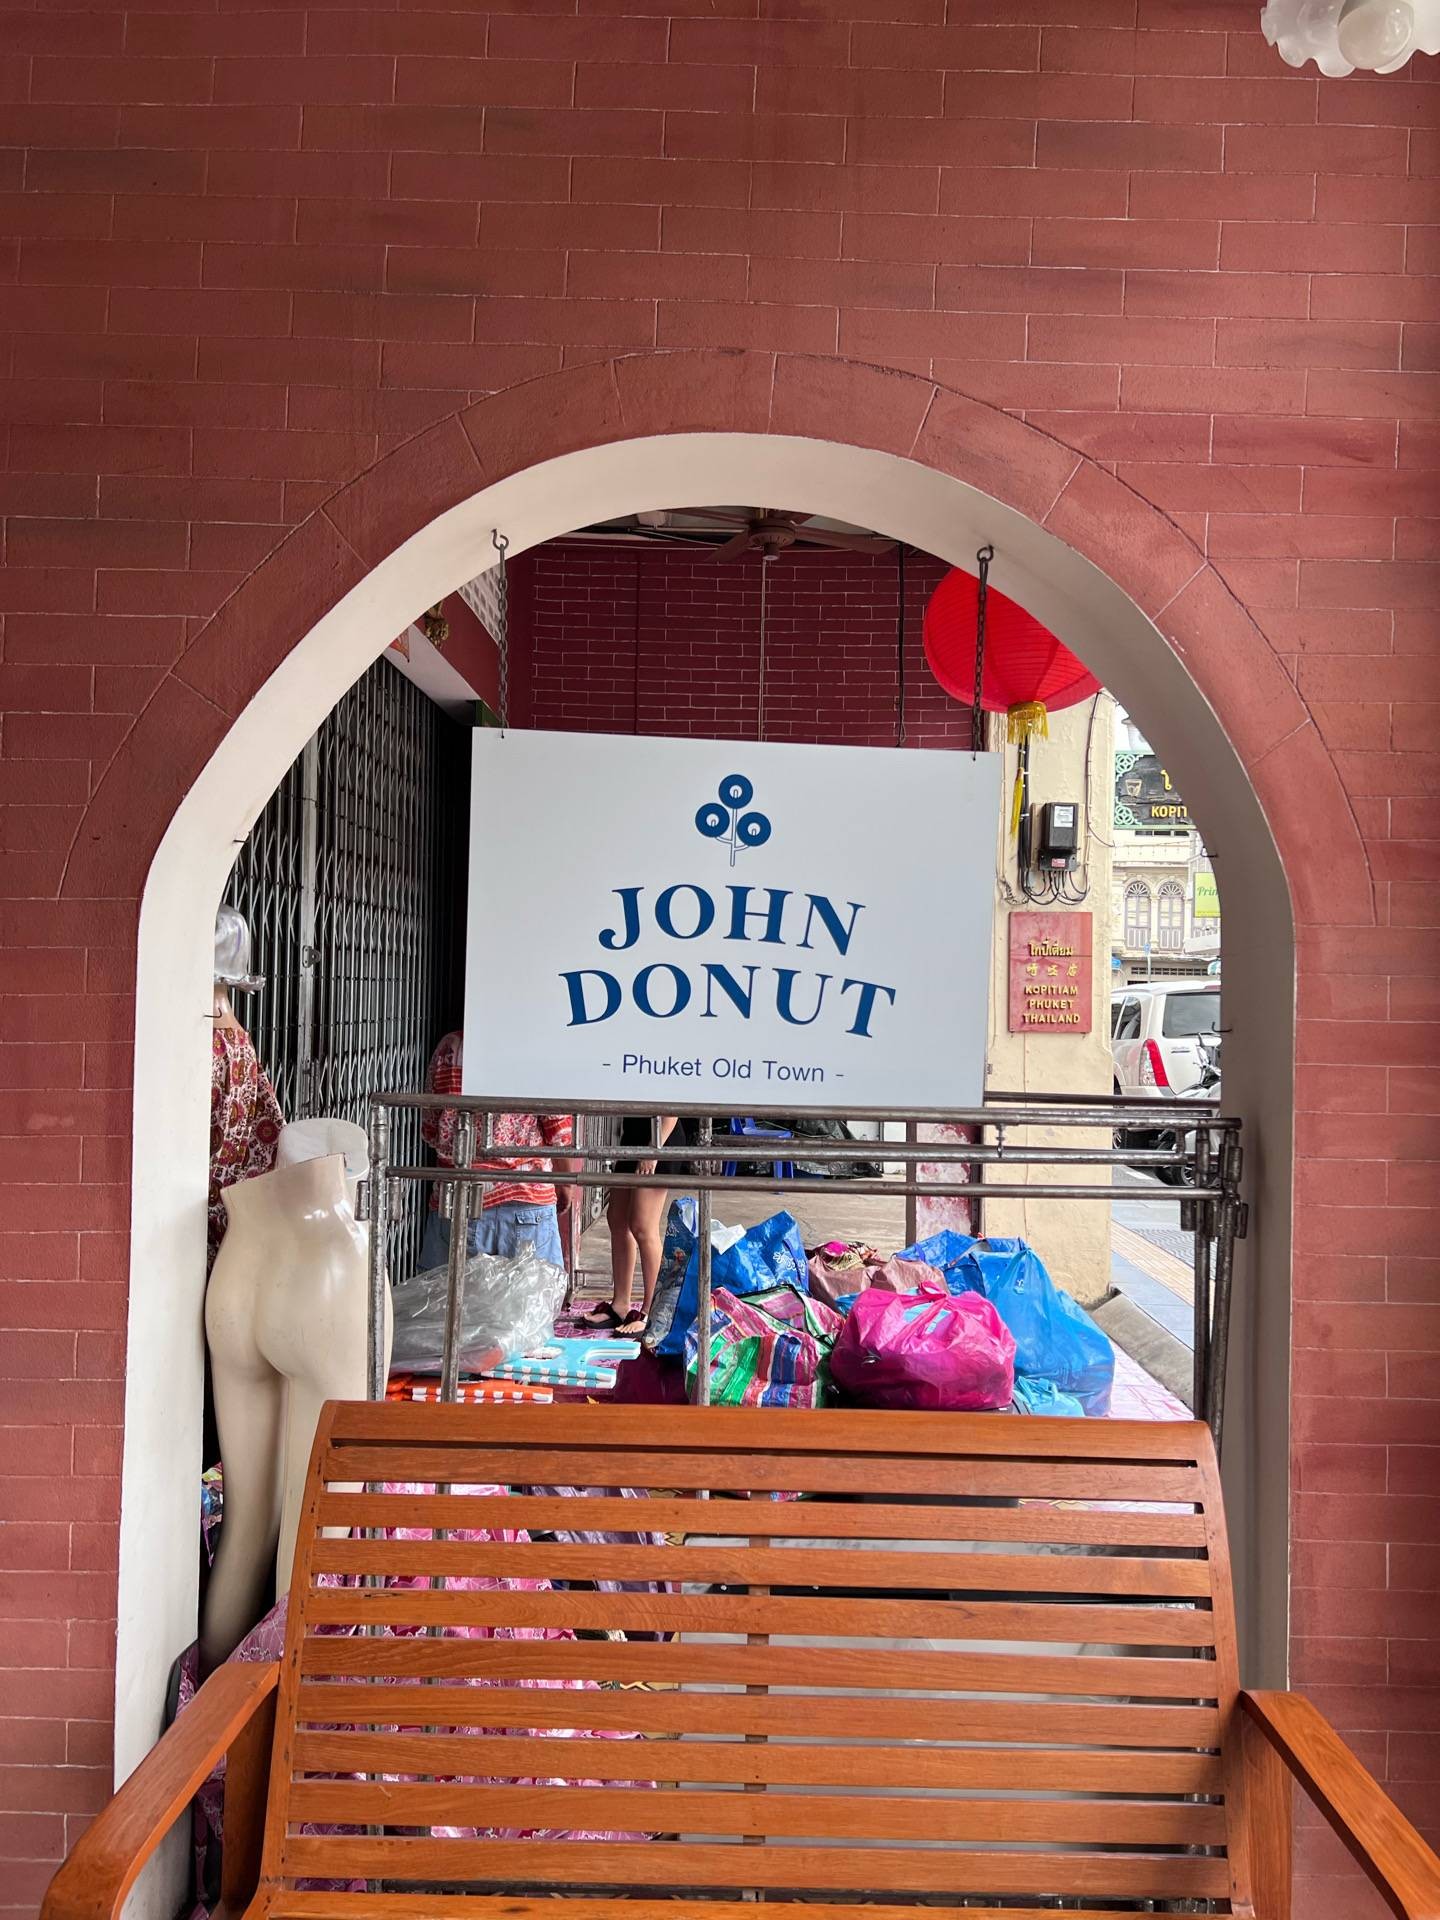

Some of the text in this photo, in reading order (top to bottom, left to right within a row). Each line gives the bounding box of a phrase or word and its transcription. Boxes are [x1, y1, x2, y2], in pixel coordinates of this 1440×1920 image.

[598, 883, 867, 957] JOHN
[557, 963, 897, 1038] DONUT
[1025, 985, 1078, 996] KOPITIAM
[1028, 999, 1074, 1010] PHUKET
[1023, 1013, 1080, 1024] THAILAND
[622, 1054, 702, 1077] Phuket
[712, 1058, 752, 1079] Old
[762, 1060, 825, 1083] Town
